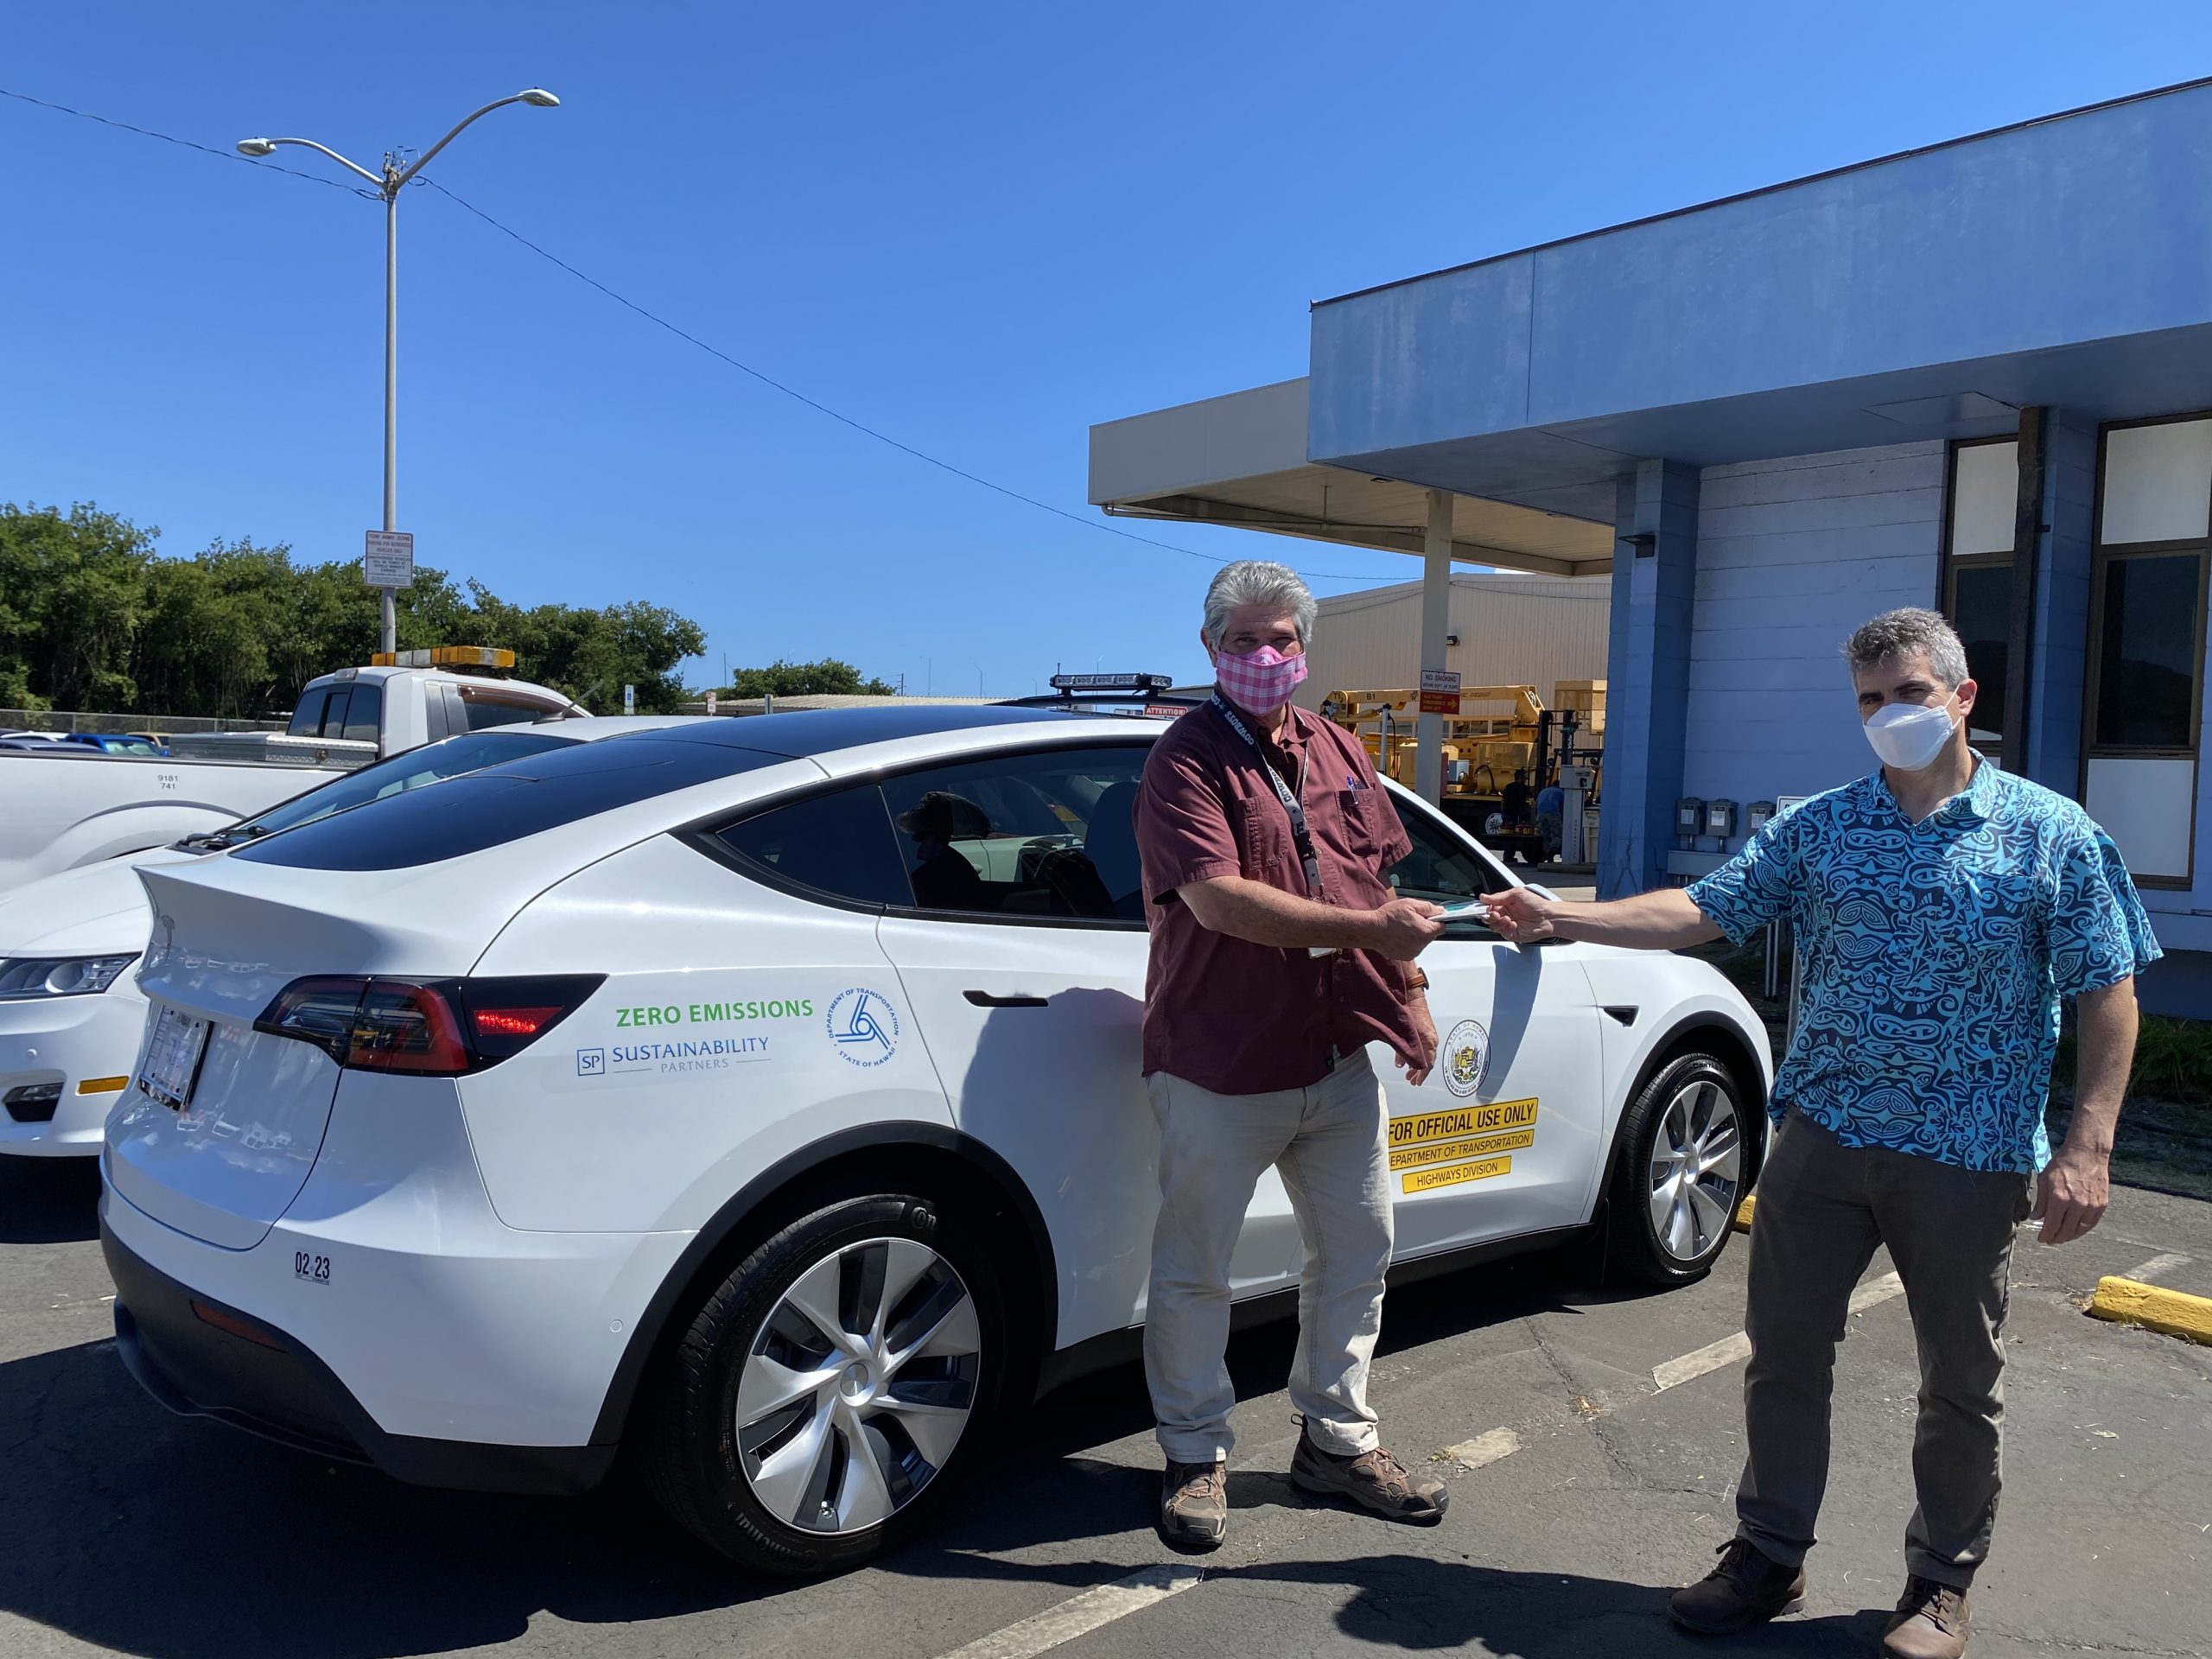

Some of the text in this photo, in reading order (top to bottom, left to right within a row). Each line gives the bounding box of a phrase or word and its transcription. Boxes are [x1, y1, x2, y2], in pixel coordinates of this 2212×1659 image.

[1146, 707, 1185, 715] ATTENTION!
[1224, 710, 1255, 746] COWBOYS
[616, 999, 814, 1027] ZERO EMISSIONS
[827, 993, 845, 1039] DEPARTMENT
[856, 988, 899, 1036] TRANSPORTATION
[1448, 1027, 1461, 1046] STATE
[582, 1055, 601, 1070] SP
[613, 1037, 769, 1063] SUSTAINABILITY
[838, 1050, 861, 1066] STATE
[873, 1046, 896, 1067] HAWAII
[661, 1058, 729, 1073] PARTNERS
[1389, 1103, 1535, 1141] FOR OFFICIAL USE ONLY
[1389, 1134, 1530, 1166] EPARTMENT OF TRANSPORTATION
[1417, 1162, 1498, 1187] HIGHWAYS DIVISION
[296, 1251, 309, 1274] 02
[315, 1255, 330, 1280] 23
